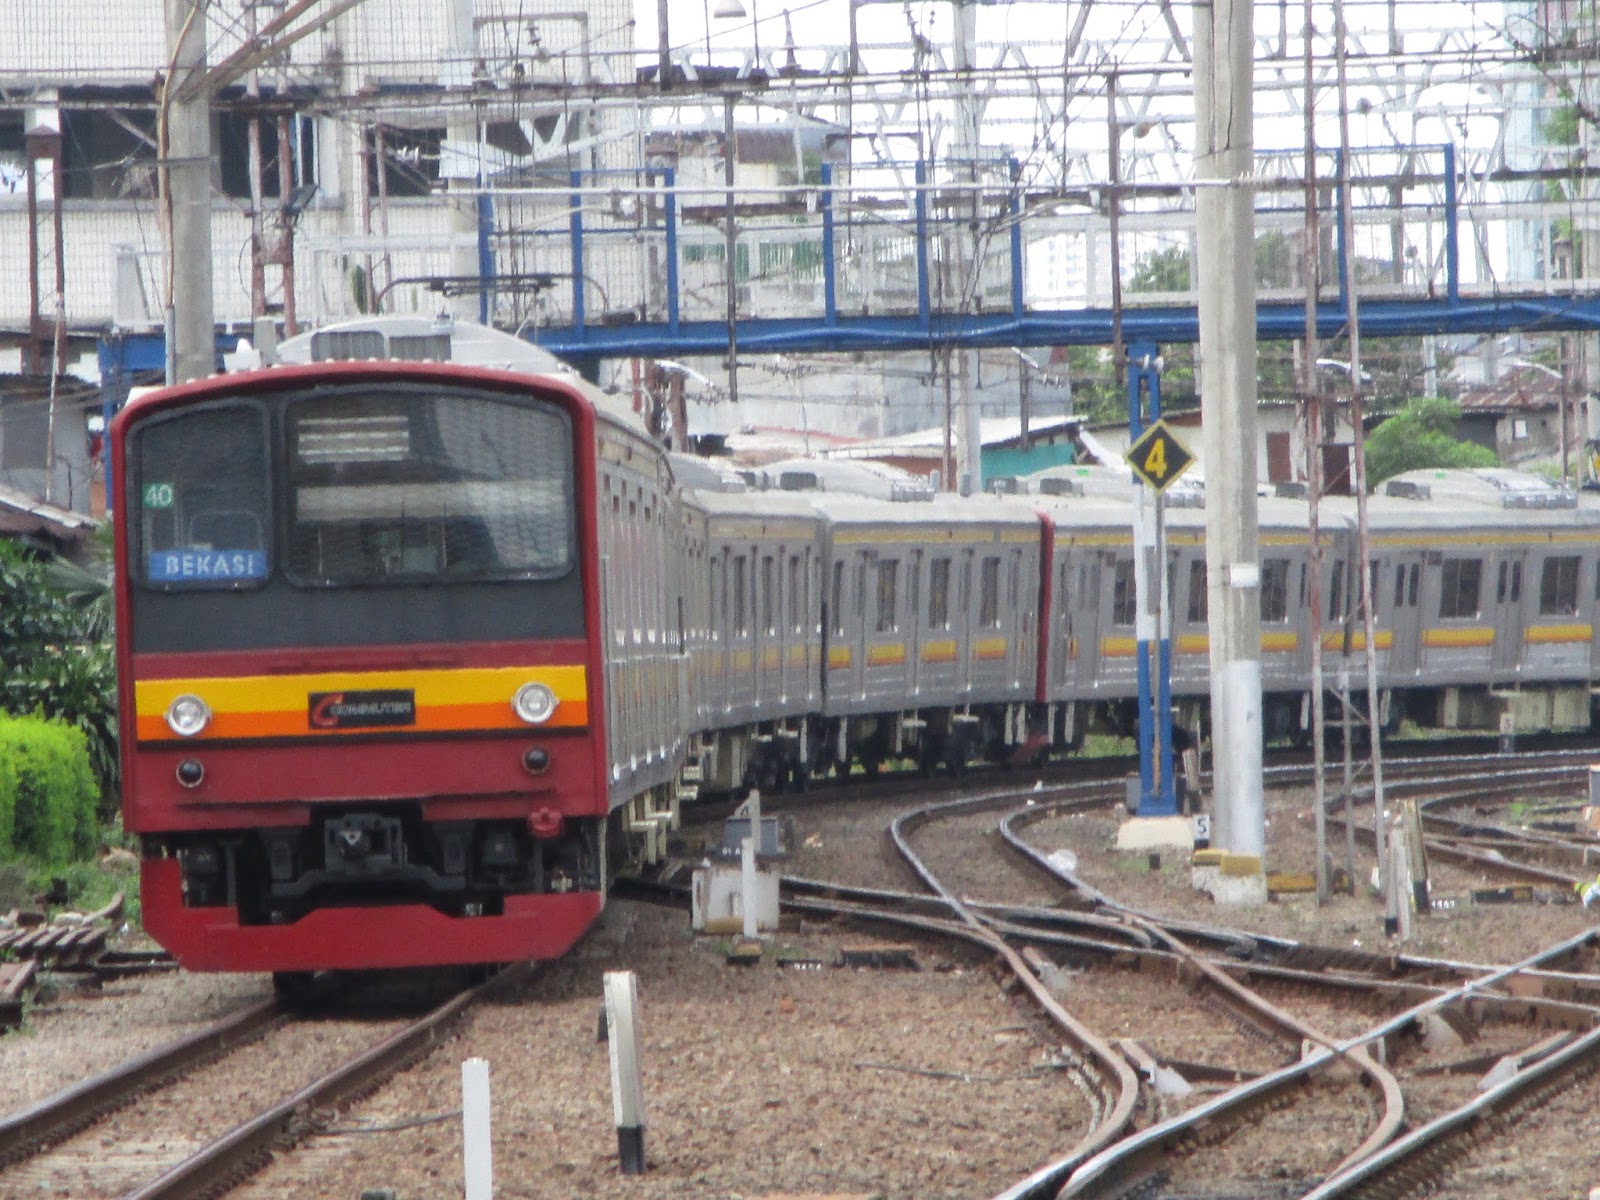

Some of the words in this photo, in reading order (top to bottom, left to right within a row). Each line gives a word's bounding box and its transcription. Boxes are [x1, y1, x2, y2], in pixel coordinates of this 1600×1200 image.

[1144, 438, 1168, 479] 4
[145, 484, 172, 507] 40
[166, 554, 254, 576] BEKASI
[1197, 818, 1207, 833] 5
